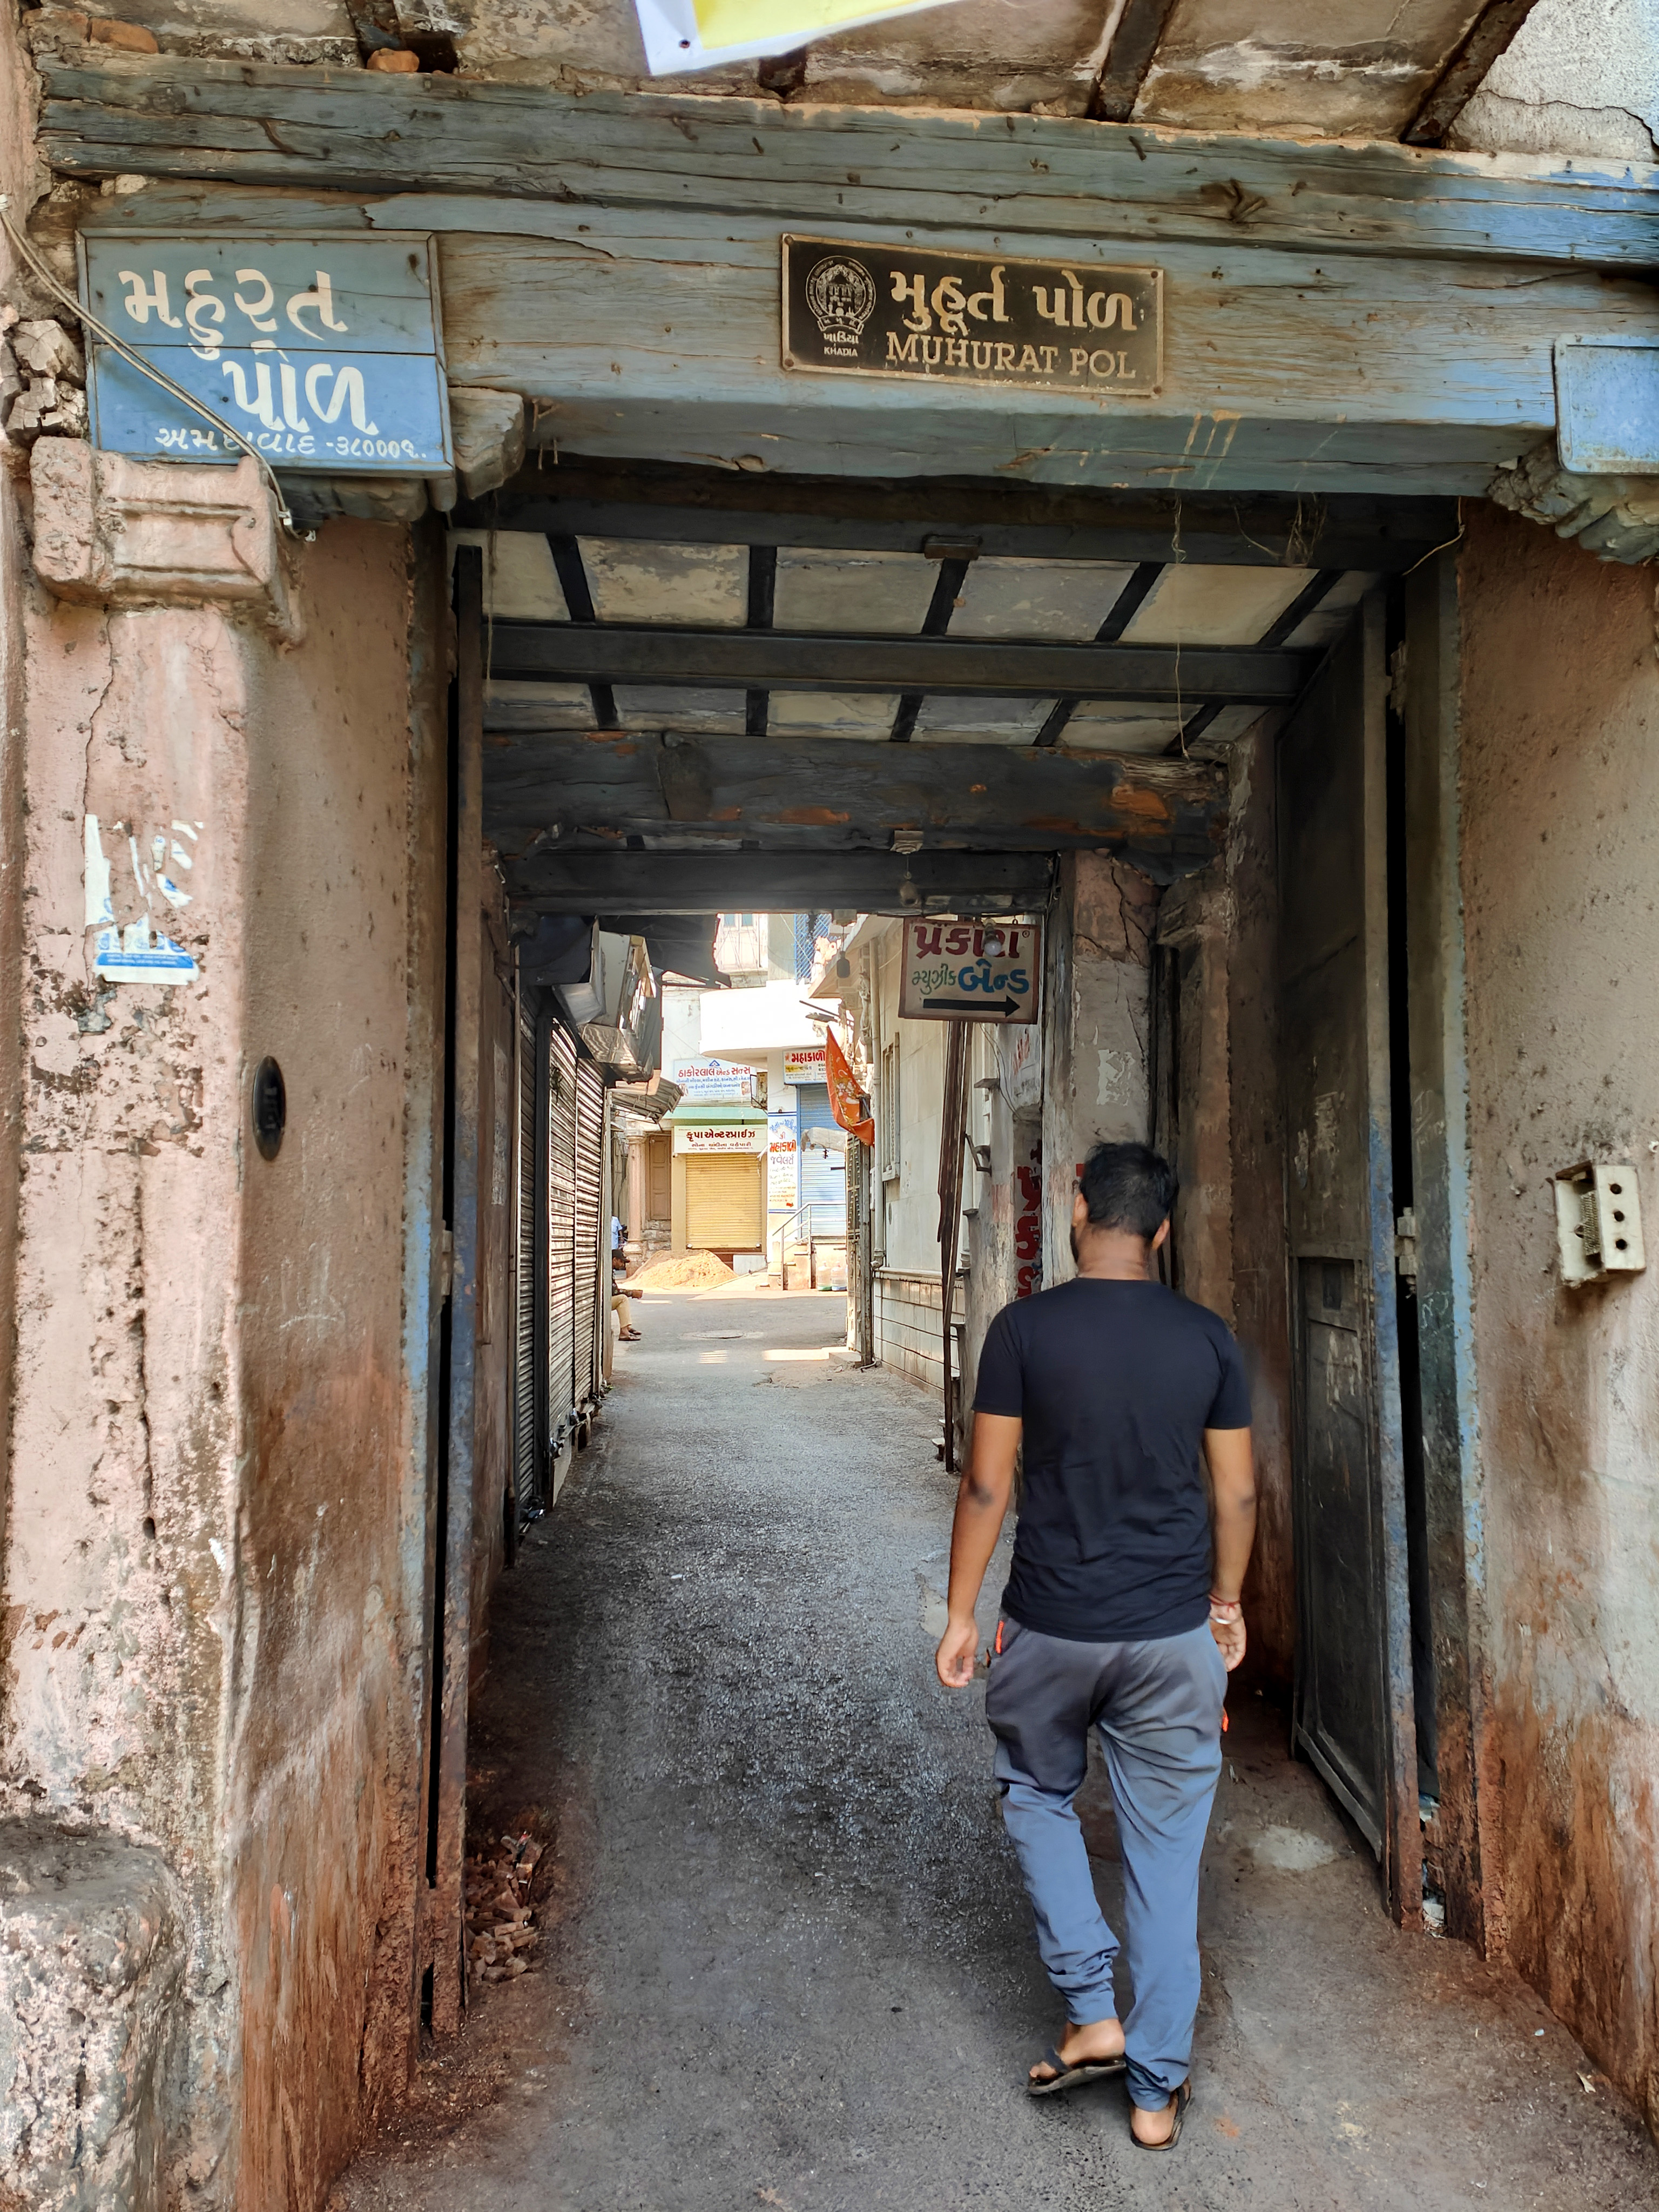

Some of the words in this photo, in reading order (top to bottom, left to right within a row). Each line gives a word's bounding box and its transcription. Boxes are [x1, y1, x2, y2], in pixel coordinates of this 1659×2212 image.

[118, 268, 348, 361] મહુરત
[890, 266, 1009, 336] મુહૂર્ત
[1033, 269, 1137, 331] પોળ
[824, 346, 858, 357] KHADIA
[887, 332, 1058, 374] MUHURAT
[1069, 348, 1136, 378] POL
[222, 340, 379, 435] પોળ
[678, 1065, 715, 1077] ઠાકોરલાલ
